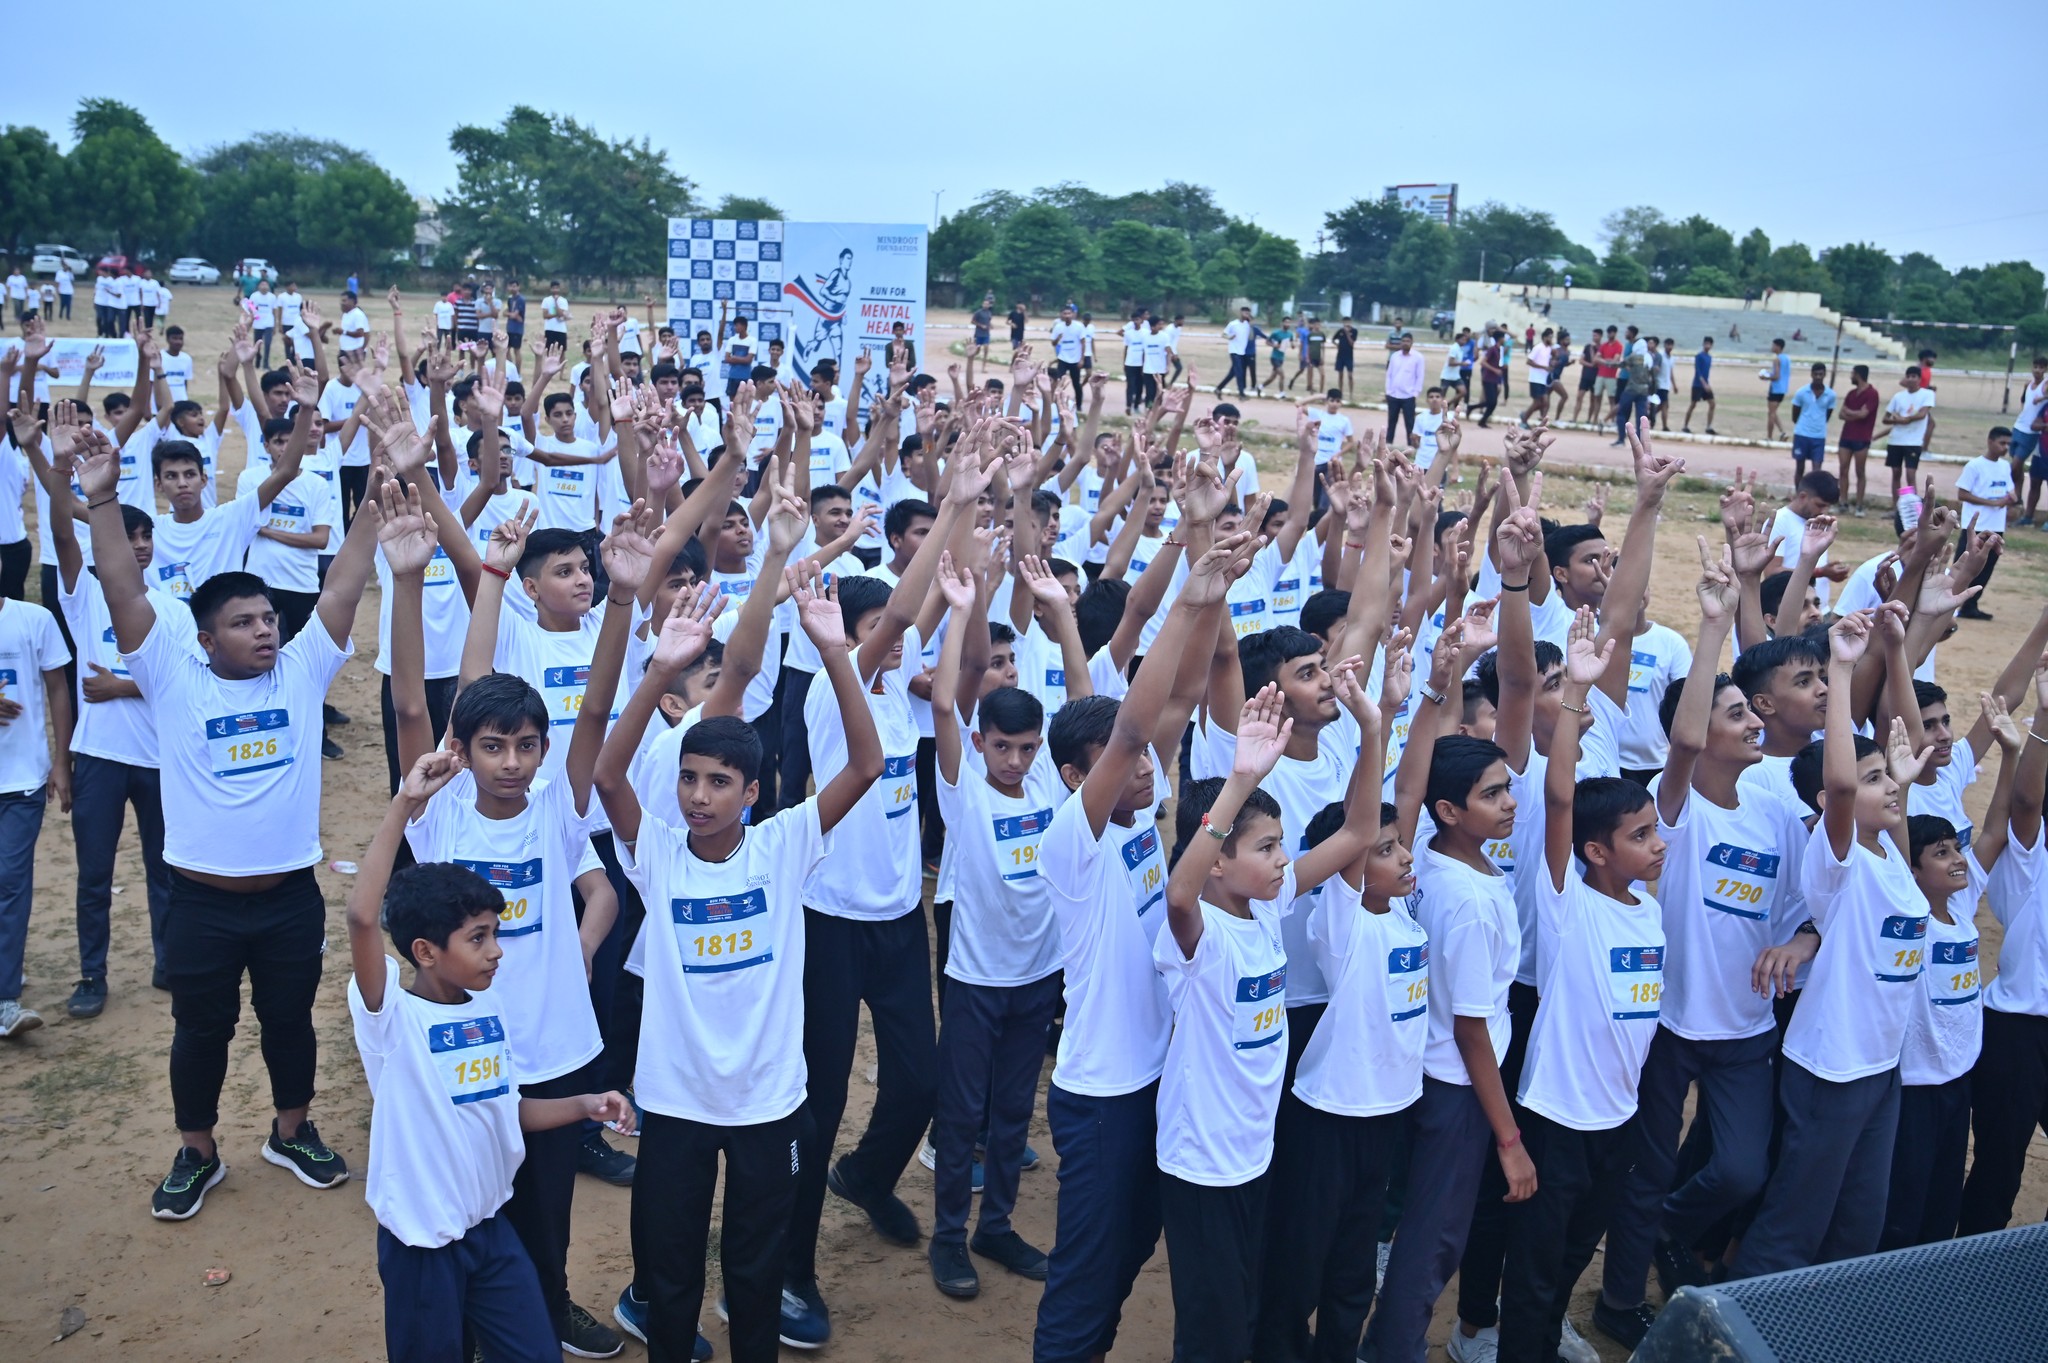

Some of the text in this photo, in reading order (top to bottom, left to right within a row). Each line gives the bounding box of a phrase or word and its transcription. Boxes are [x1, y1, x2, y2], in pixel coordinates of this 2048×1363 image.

[870, 286, 906, 296] RUN FOR
[861, 304, 910, 319] MENTAL
[866, 321, 914, 336] HEAH
[556, 482, 577, 492] 1848
[269, 518, 296, 529] 1517
[425, 565, 450, 577] 823
[1235, 620, 1261, 634] 1656
[562, 694, 584, 711] 18
[227, 738, 277, 762] 1826
[894, 783, 911, 804] 18
[1011, 844, 1039, 865] 19
[1488, 842, 1514, 859] 18
[1142, 864, 1161, 895] 180
[1714, 879, 1763, 904] 1790
[499, 898, 527, 922] 80
[693, 930, 753, 957] 1813
[1894, 948, 1923, 967] 184
[1407, 976, 1428, 1003] 162
[1951, 969, 1978, 991] 189
[1630, 983, 1661, 1003] 189
[454, 1055, 500, 1085] 1596
[790, 1139, 799, 1175] PERFECT
